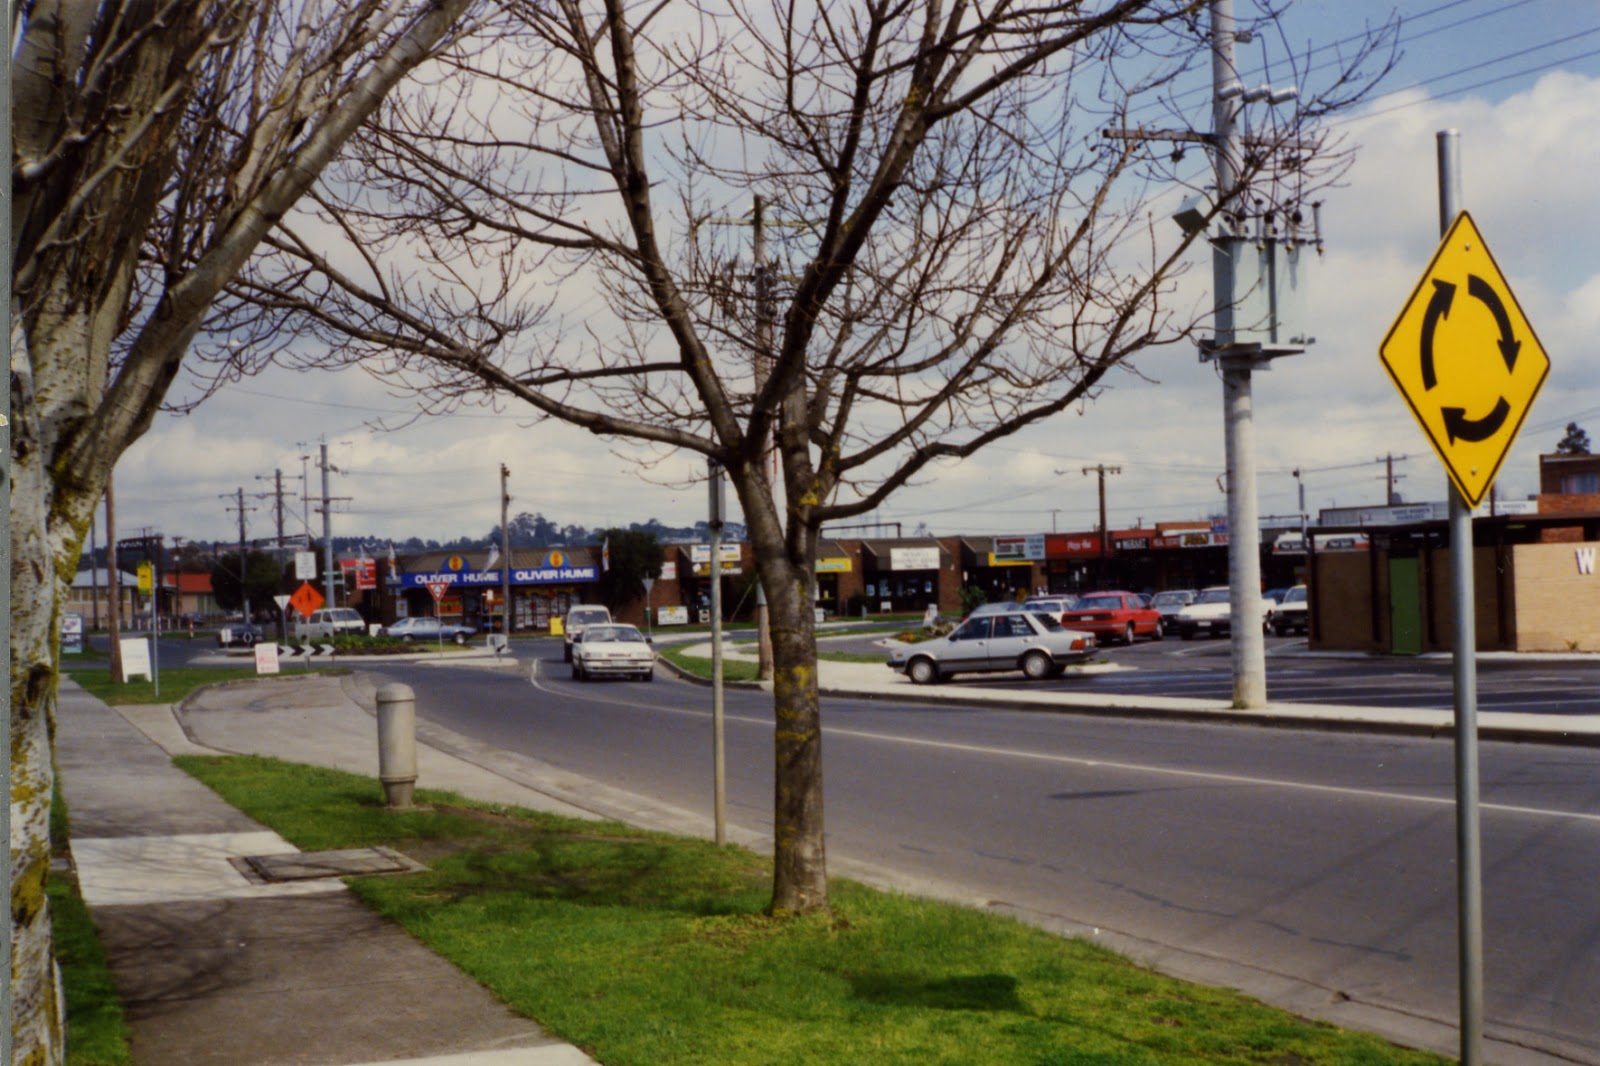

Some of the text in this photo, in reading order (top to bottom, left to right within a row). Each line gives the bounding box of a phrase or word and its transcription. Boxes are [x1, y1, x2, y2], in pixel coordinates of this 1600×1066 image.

[414, 572, 499, 584] OLIVER HUME
[514, 567, 595, 581] OLIVER HUME
